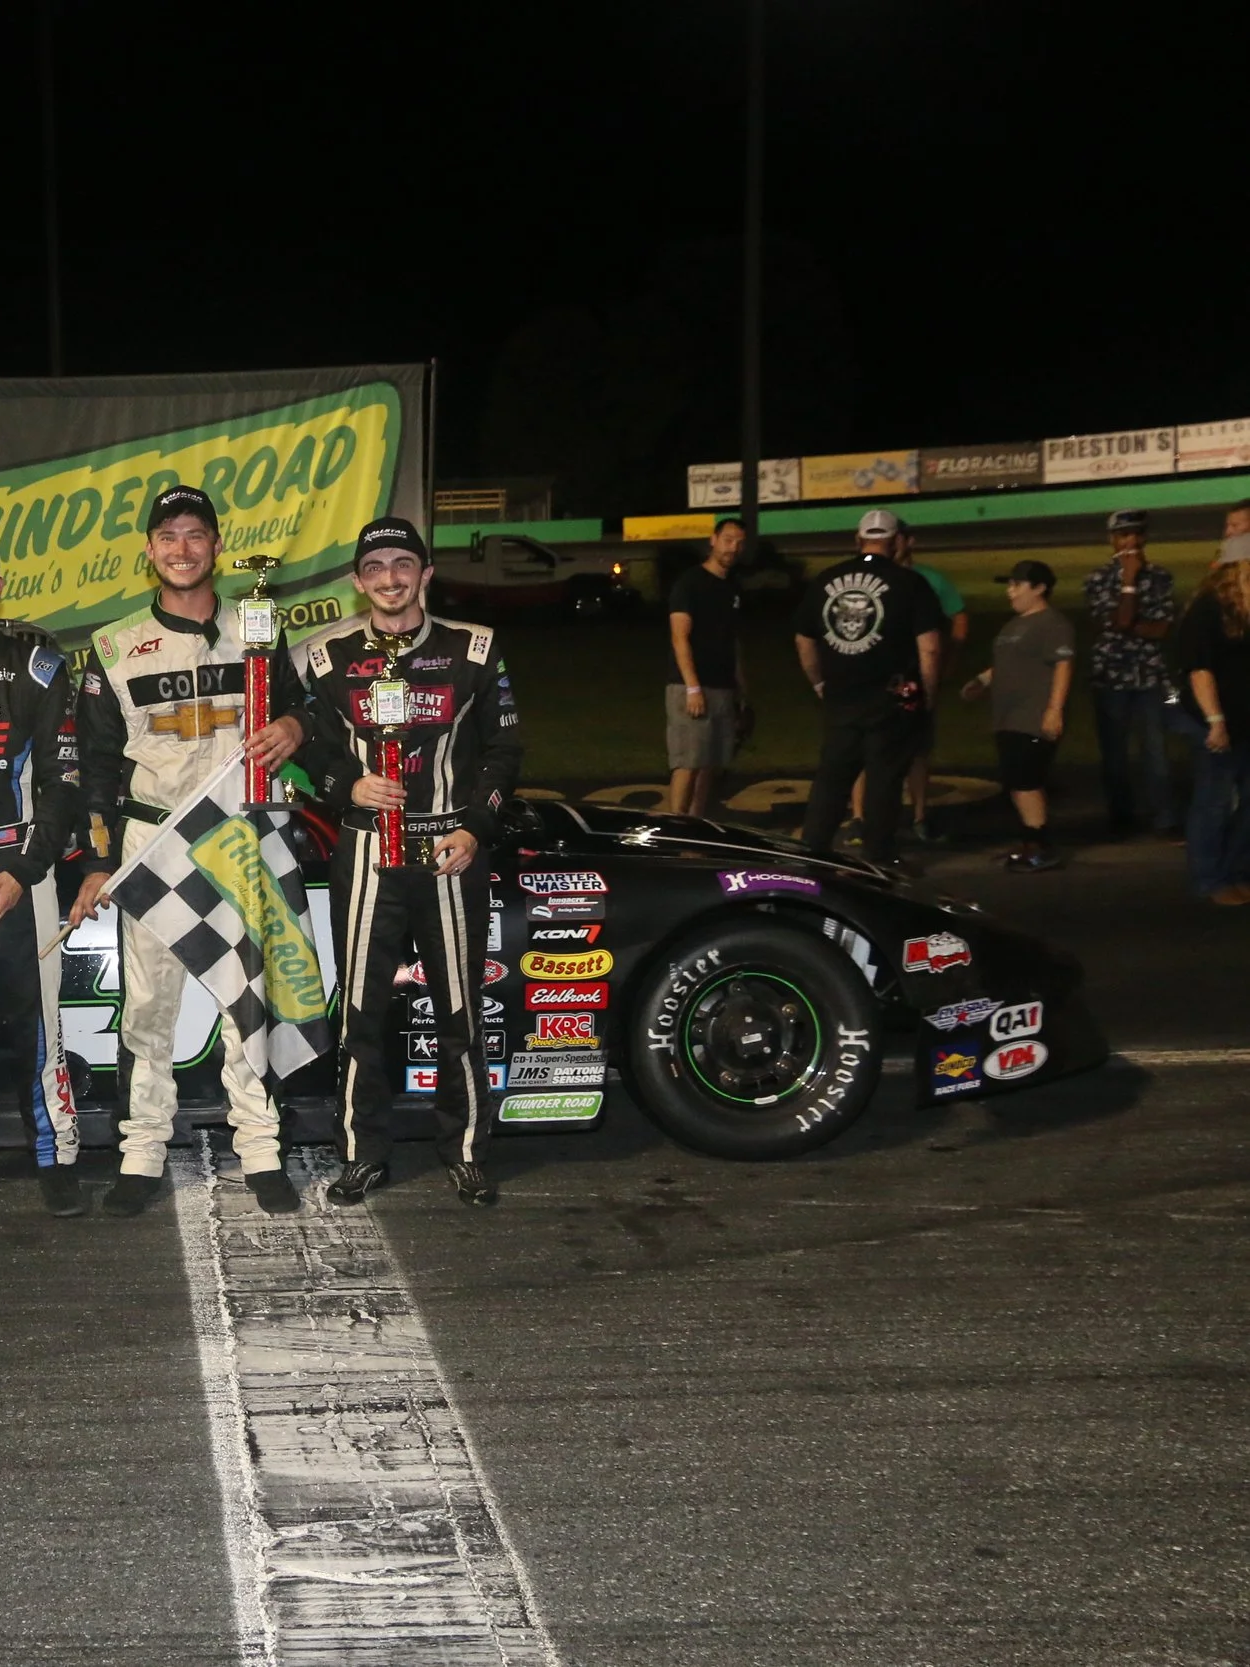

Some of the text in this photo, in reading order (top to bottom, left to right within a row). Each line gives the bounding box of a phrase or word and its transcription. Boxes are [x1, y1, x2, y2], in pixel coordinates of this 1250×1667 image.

[1048, 431, 1171, 462] PRESTON'S
[204, 424, 357, 517] ROAD
[937, 452, 1039, 472] FLORACING
[77, 549, 122, 589] site
[127, 638, 163, 658] ACT
[347, 657, 386, 676] ACT
[158, 668, 225, 699] CODY
[409, 706, 442, 717] entals
[408, 817, 463, 832] GRAVEL
[521, 873, 598, 887] QUARTER
[535, 881, 603, 893] MASTER
[748, 874, 816, 887] HOOSIER
[532, 928, 590, 940] KONI
[529, 954, 604, 974] Bassett
[531, 988, 602, 1005] Edelbrock
[647, 949, 720, 1055] Hoosier
[537, 1014, 594, 1040] KRC
[996, 1005, 1039, 1035] QA1
[526, 1034, 601, 1050] Power Steering
[513, 1055, 533, 1064] CD-1
[935, 1056, 976, 1073] SUNOCO
[510, 1066, 605, 1080] JMS DAYTONA
[552, 1074, 604, 1084] SENSORS
[795, 1023, 870, 1133] Hoosier
[507, 1097, 596, 1110] THUNDER ROAD
